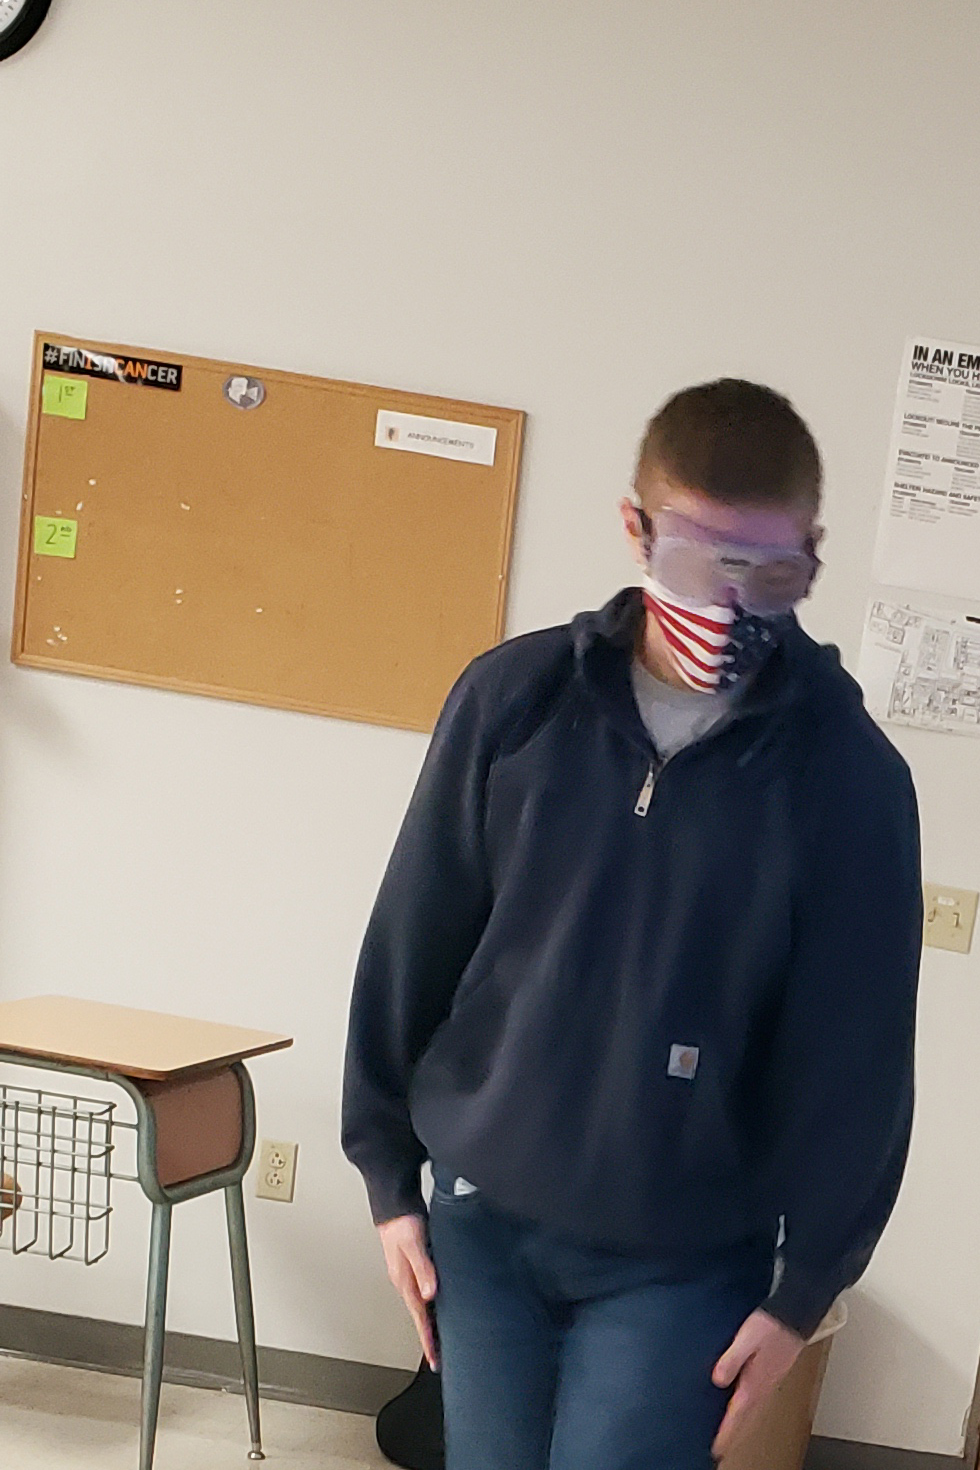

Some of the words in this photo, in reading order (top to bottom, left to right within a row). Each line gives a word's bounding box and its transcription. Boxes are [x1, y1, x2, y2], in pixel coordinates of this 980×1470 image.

[913, 345, 929, 362] IN
[931, 348, 954, 366] AN
[911, 361, 944, 375] WHEN
[947, 367, 969, 380] YOU
